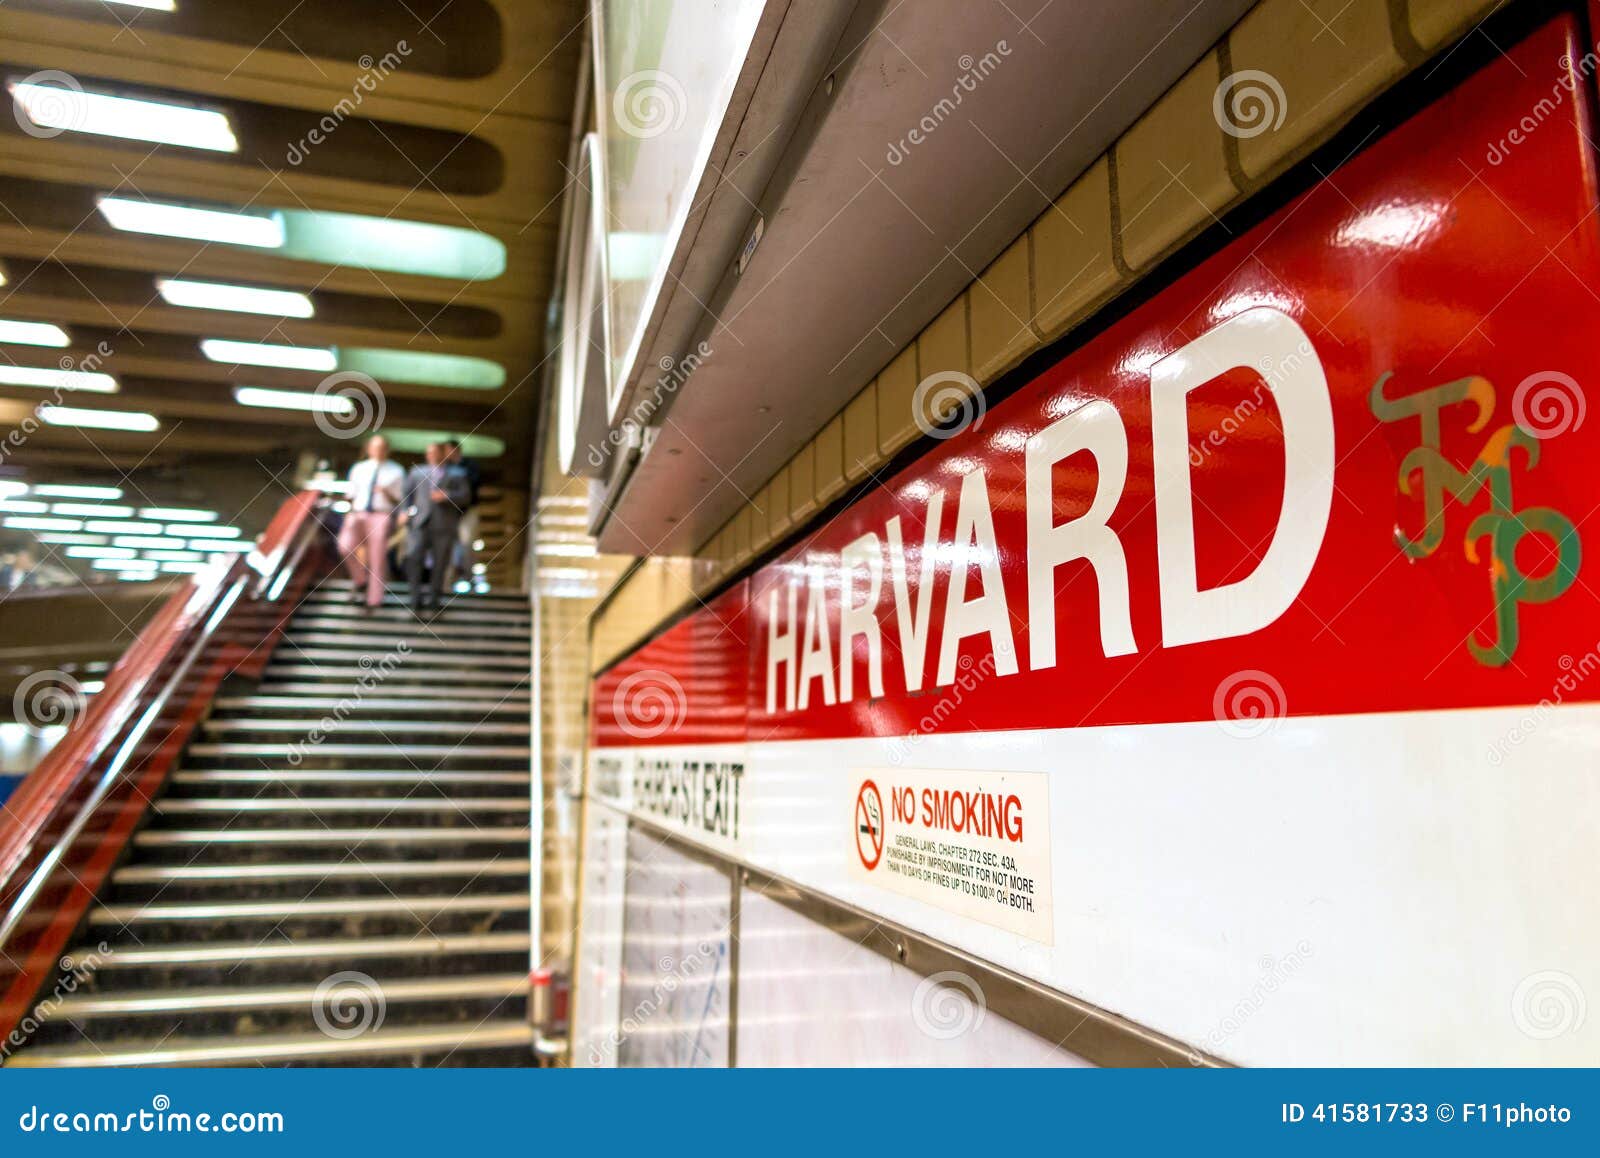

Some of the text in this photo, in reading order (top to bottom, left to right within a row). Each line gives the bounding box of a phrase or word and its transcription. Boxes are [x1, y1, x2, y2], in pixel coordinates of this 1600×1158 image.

[766, 305, 1336, 714] HARVARD
[704, 760, 744, 840] EXIT
[892, 786, 1023, 843] NO SMOKING
[887, 846, 1034, 894] PUNISHABLE BY IMPRISONMENT FOR NOT MORE
[896, 835, 919, 850] GENERAL
[938, 843, 967, 861] CHAPTER
[969, 849, 980, 863] 272
[983, 851, 999, 867] SEC.
[888, 860, 900, 873] THAN
[901, 864, 907, 876] 10
[908, 866, 922, 880] DAYS
[923, 870, 931, 882] OR
[932, 872, 950, 888] FINES
[951, 877, 960, 890] UP
[961, 880, 970, 894] TO
[997, 889, 1008, 905] OR
[1010, 893, 1035, 913] BOTH.
